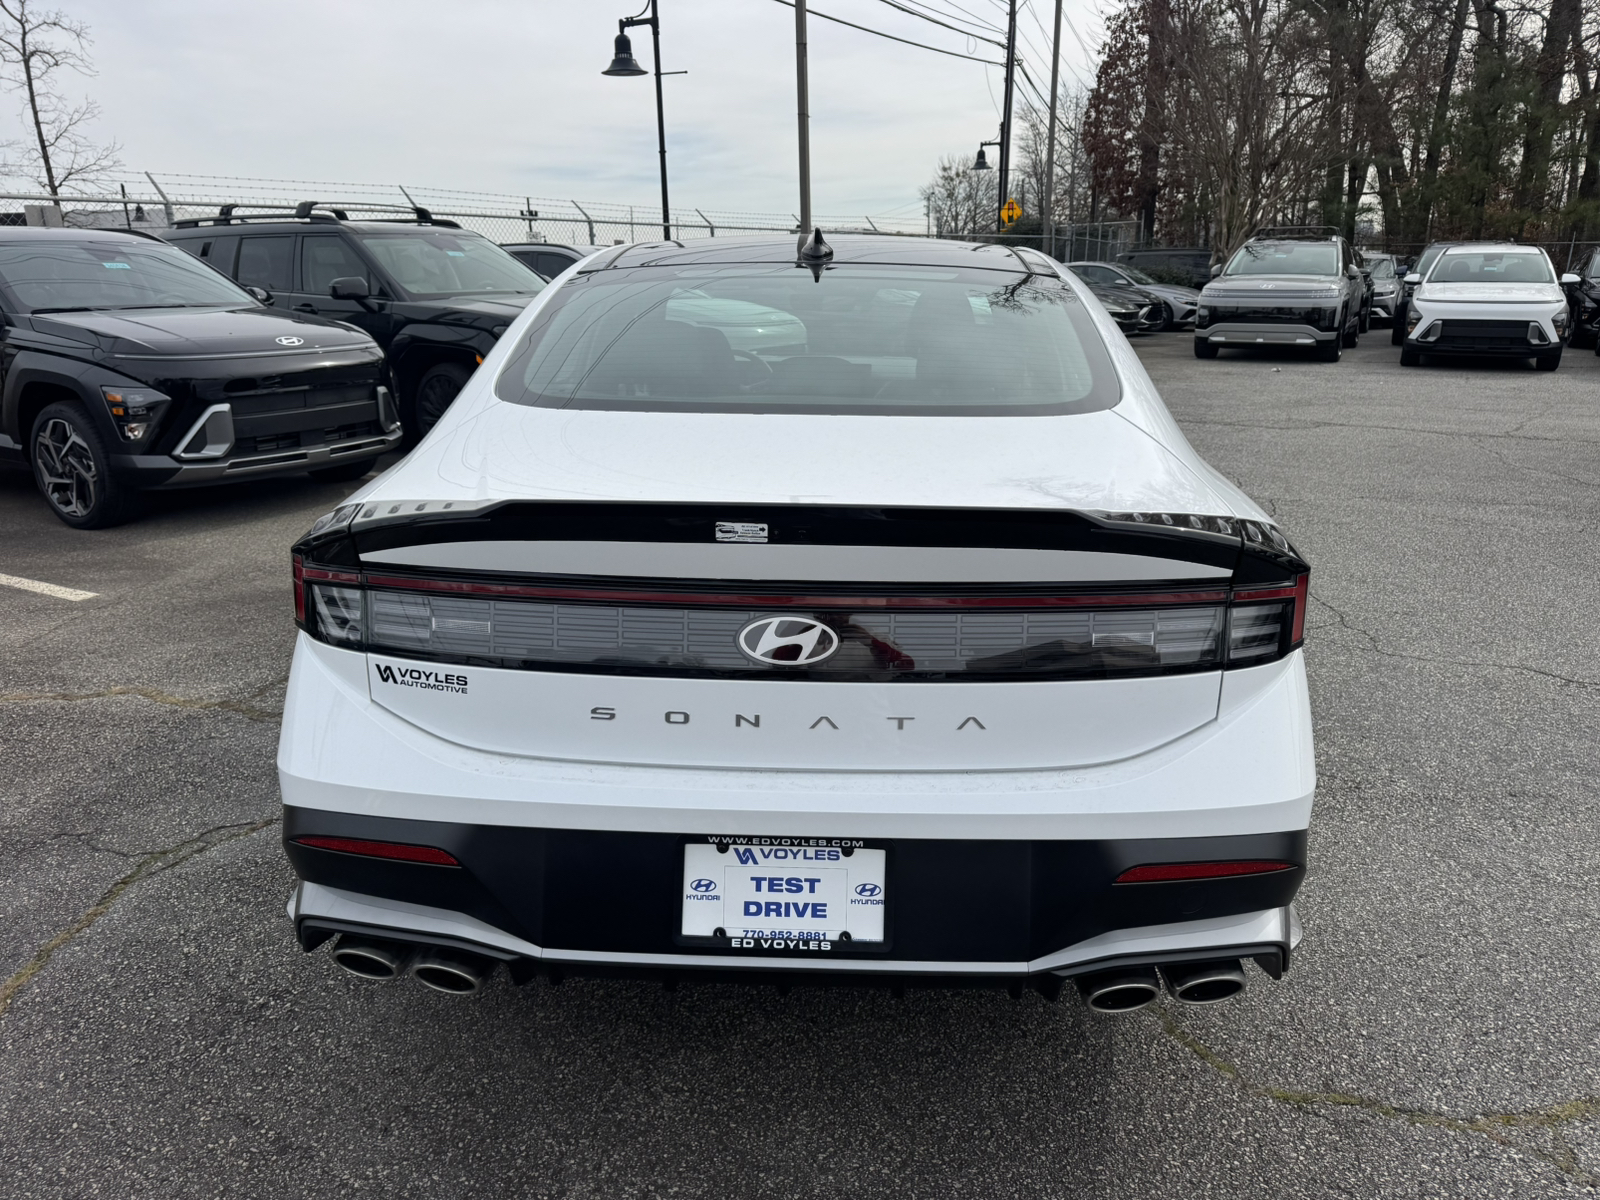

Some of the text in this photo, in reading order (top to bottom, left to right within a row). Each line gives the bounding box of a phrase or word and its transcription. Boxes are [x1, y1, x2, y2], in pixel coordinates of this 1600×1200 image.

[397, 667, 468, 686] VOYLES
[400, 679, 468, 694] AUTOMOTIVE
[590, 706, 987, 731] SONATA
[707, 836, 864, 847] WWW.EDVOYLES.COM
[759, 848, 841, 861] VOYLES
[750, 876, 821, 894] TEST
[743, 900, 828, 919] DRIVE
[742, 929, 827, 940] 770-952-8881
[731, 938, 832, 951] ED VOYLES
